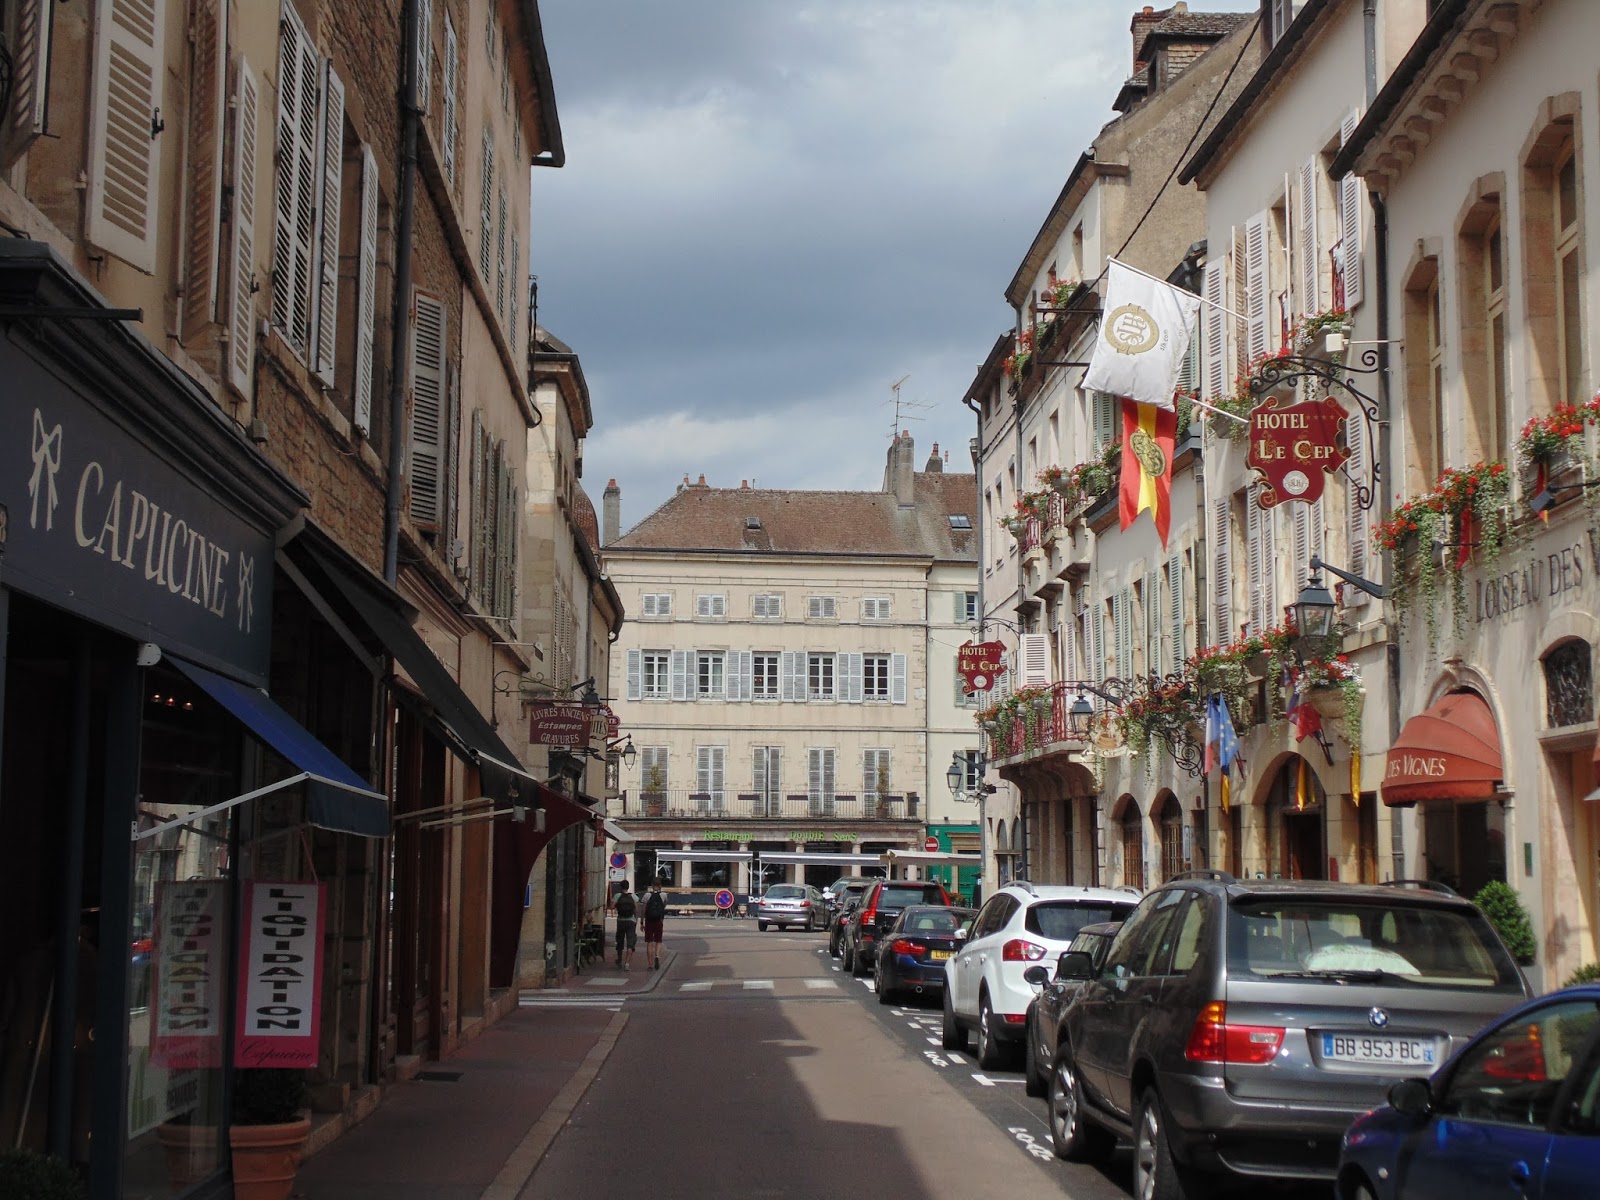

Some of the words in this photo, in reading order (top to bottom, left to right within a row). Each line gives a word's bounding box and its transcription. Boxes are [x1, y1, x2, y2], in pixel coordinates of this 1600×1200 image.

[1257, 413, 1309, 429] HOTEL
[1259, 439, 1286, 460] LE
[1294, 440, 1335, 460] CEP
[75, 461, 230, 619] CAPUCINE
[1475, 559, 1544, 623] LOISEAU
[1547, 543, 1583, 597] DES
[962, 648, 988, 656] HOTEL
[963, 660, 976, 670] LE
[979, 661, 1000, 671] CEP
[532, 707, 558, 720] LIVRES
[560, 707, 590, 722] ANCIENS
[538, 721, 583, 731] Estampes
[540, 733, 580, 744] GRAVURES
[1387, 760, 1401, 778] DES
[1403, 754, 1446, 776] VIGNES
[704, 830, 754, 841] Restaurant
[256, 888, 307, 1029] LIQUIDATION
[1335, 1037, 1421, 1060] BB-953-BC
